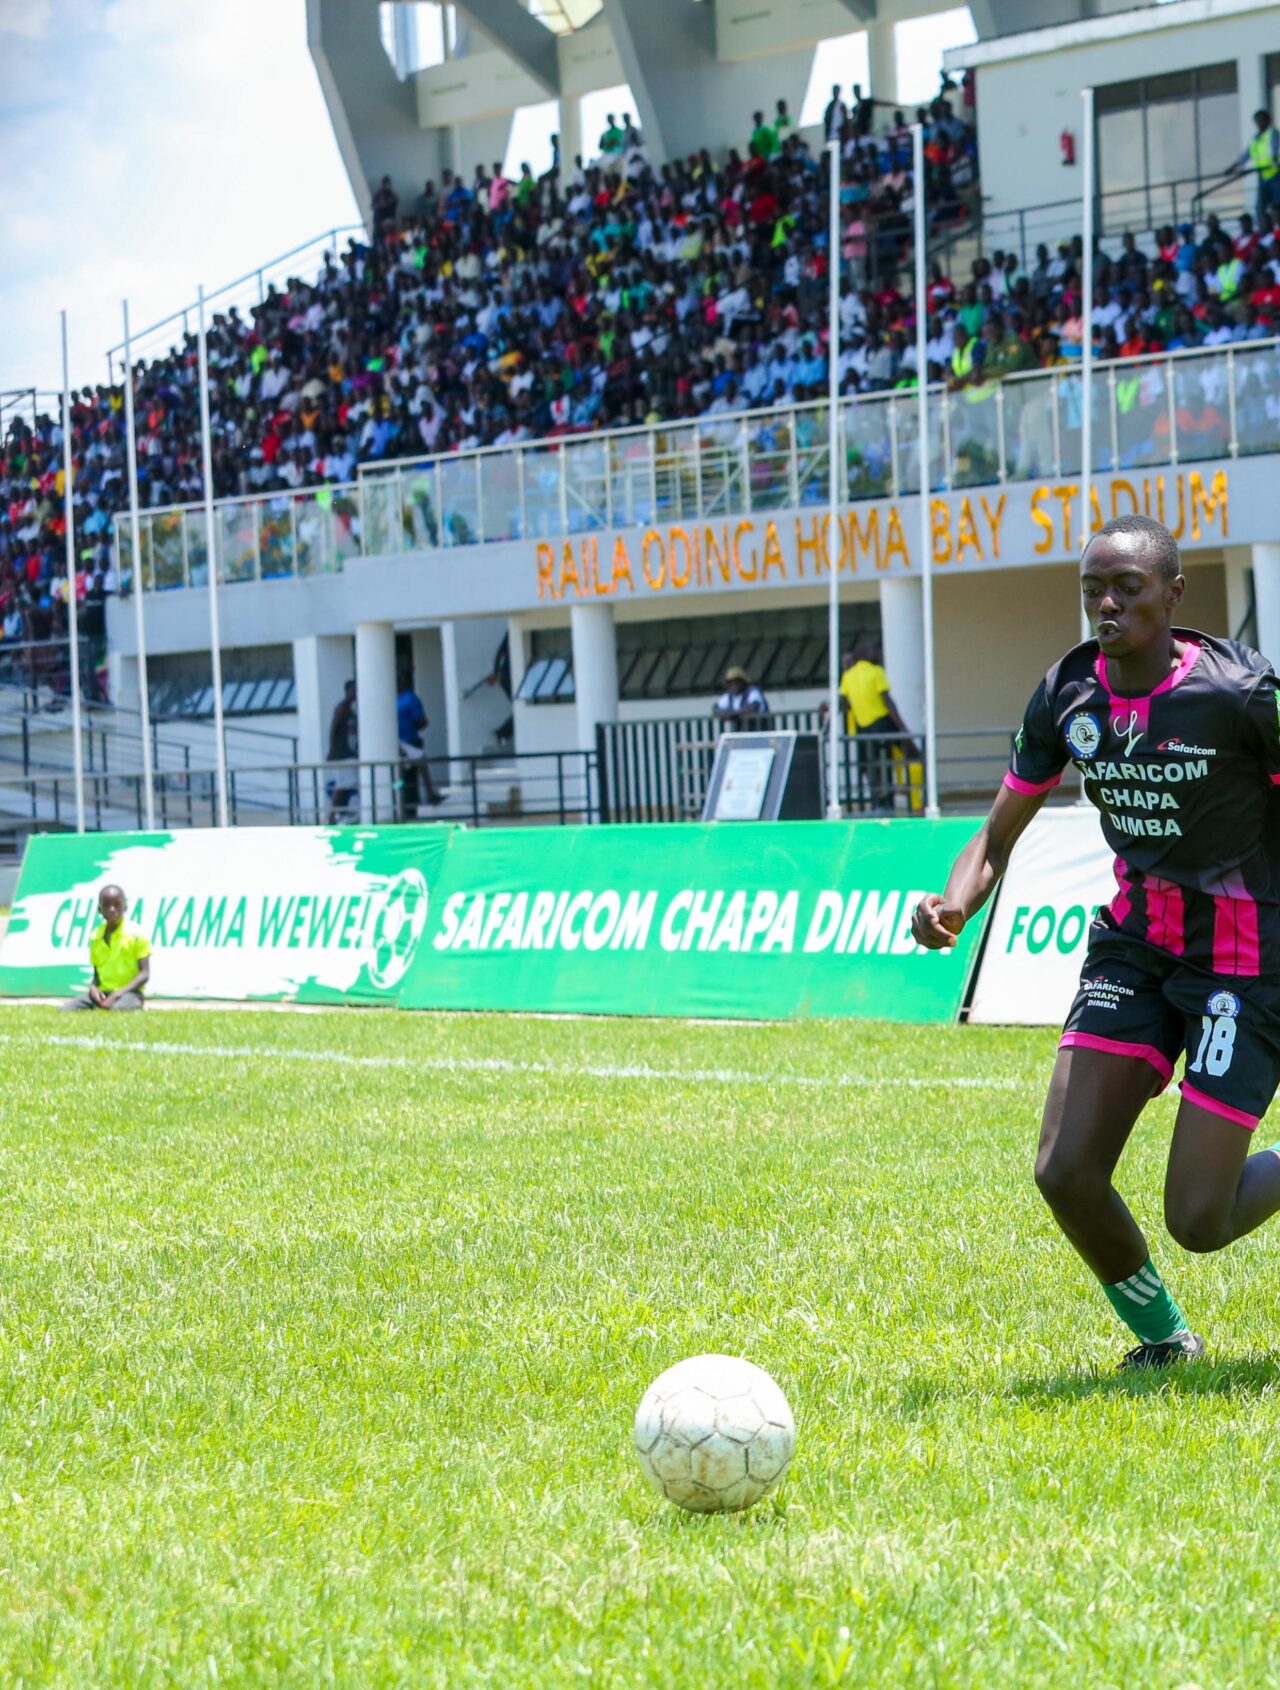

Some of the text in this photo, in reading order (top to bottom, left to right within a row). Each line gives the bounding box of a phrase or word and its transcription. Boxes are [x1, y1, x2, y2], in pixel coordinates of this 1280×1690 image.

[537, 536, 635, 599] RAILA
[642, 520, 787, 590] ODINGA
[795, 506, 911, 577] HOMA
[929, 493, 1007, 564] BAY
[1167, 741, 1217, 756] Safaricom
[1100, 787, 1180, 811] CHAPA
[1109, 812, 1183, 837] DIMBA
[151, 895, 248, 948] KAMA
[257, 895, 372, 950] WEWE!
[432, 888, 952, 955] SAFARICOM CHAPA DIMB
[1006, 904, 1100, 955] FOO
[1087, 1000, 1118, 1011] DIMBA
[1088, 991, 1120, 1002] CHAPA
[1189, 1015, 1237, 1077] 18
